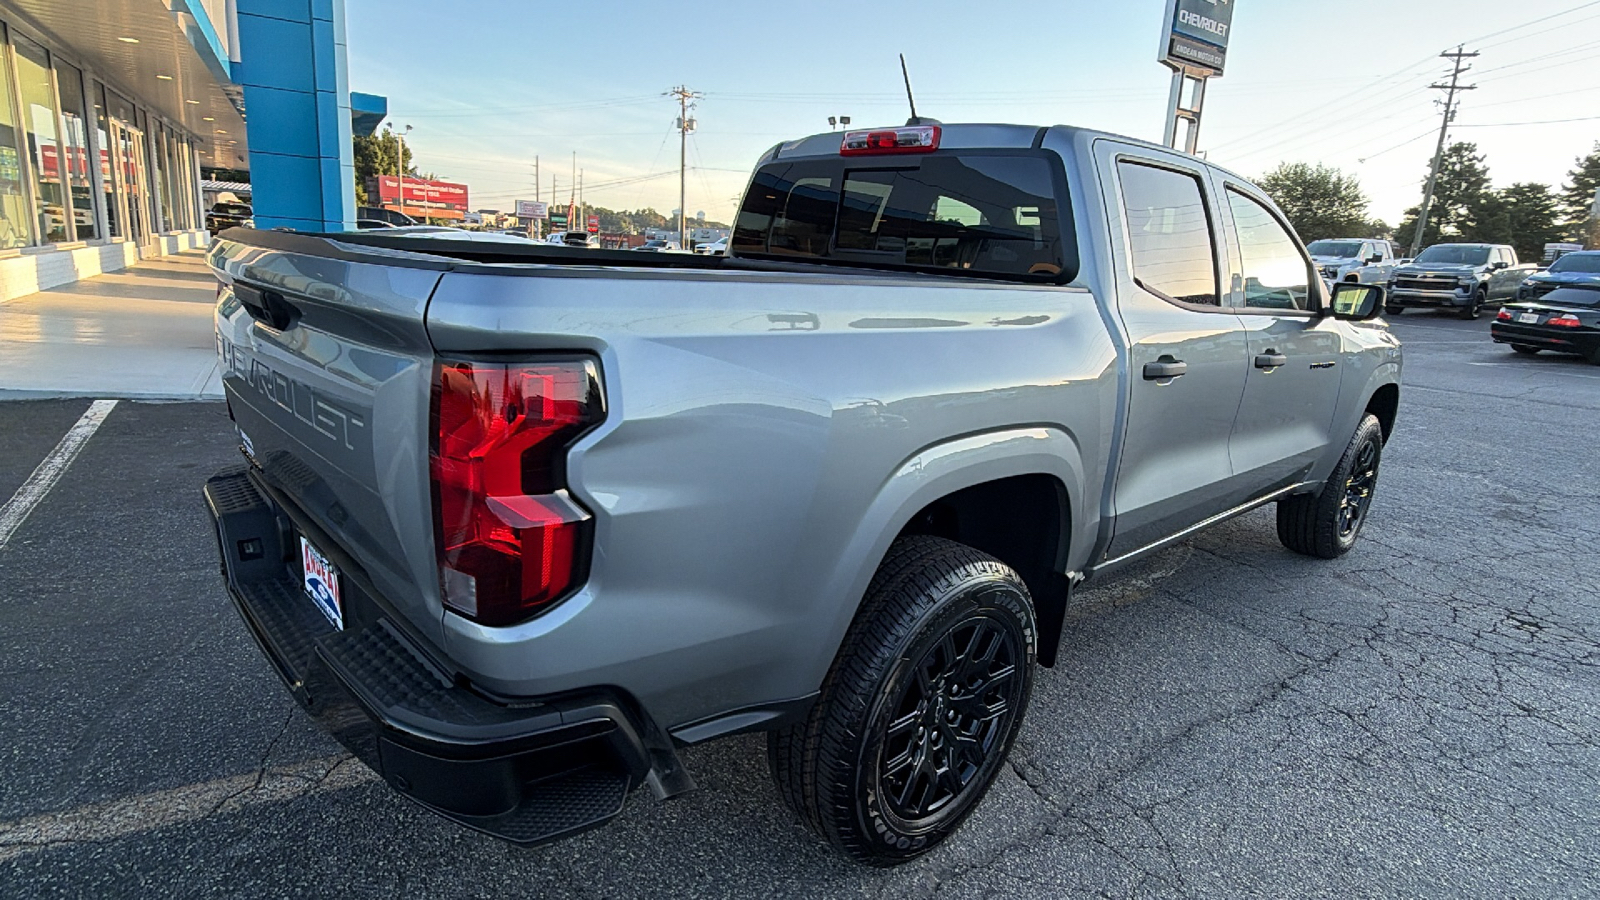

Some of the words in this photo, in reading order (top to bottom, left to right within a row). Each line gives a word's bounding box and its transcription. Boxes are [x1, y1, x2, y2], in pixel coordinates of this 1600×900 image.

[1179, 9, 1228, 37] CHEVROLET
[1197, 51, 1214, 62] MOTOR
[215, 330, 364, 450] CHEVROLET
